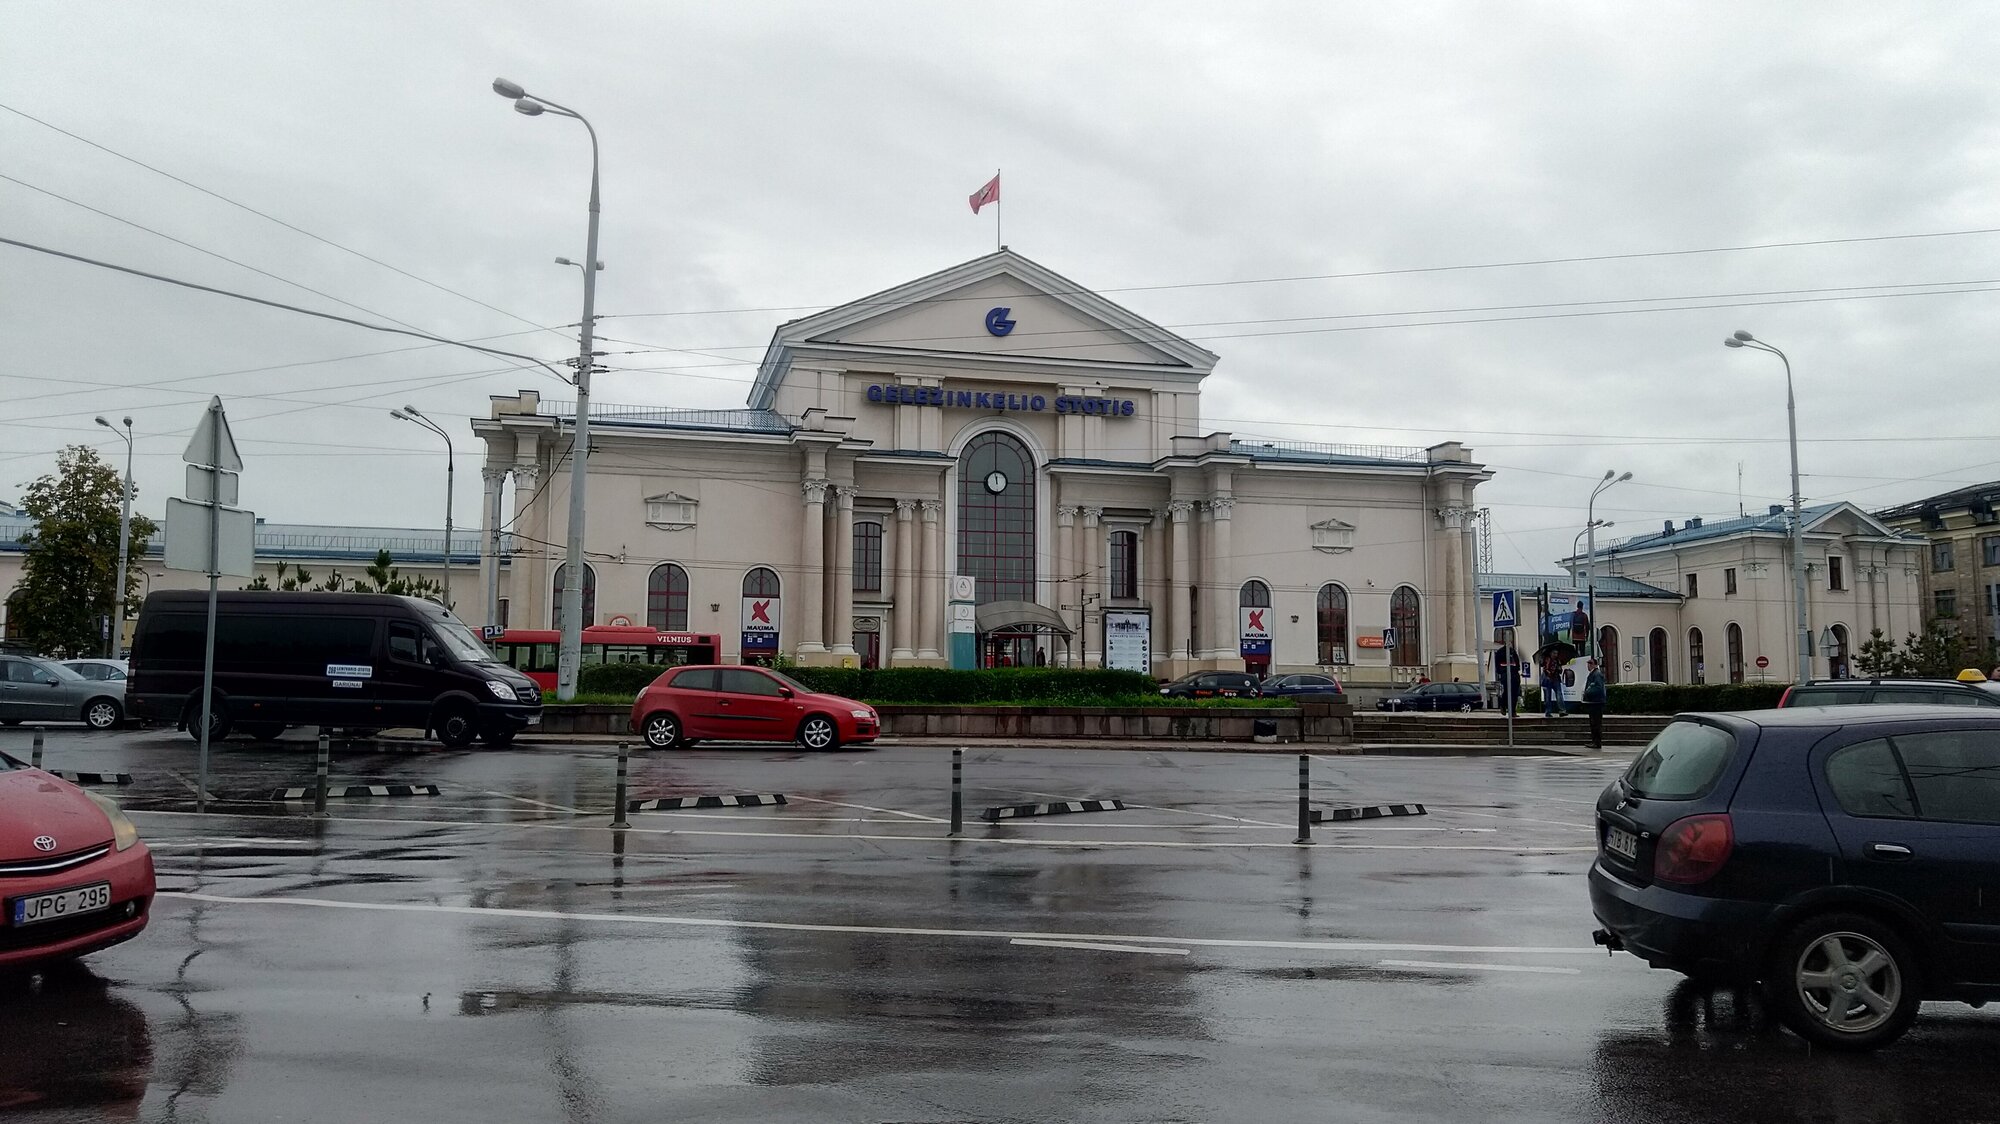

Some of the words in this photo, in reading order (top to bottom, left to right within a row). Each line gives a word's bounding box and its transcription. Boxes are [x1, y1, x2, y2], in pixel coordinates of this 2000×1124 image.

[1055, 396, 1135, 416] STOTIS
[484, 627, 494, 640] P
[27, 895, 66, 919] JPG
[78, 887, 108, 910] 295
